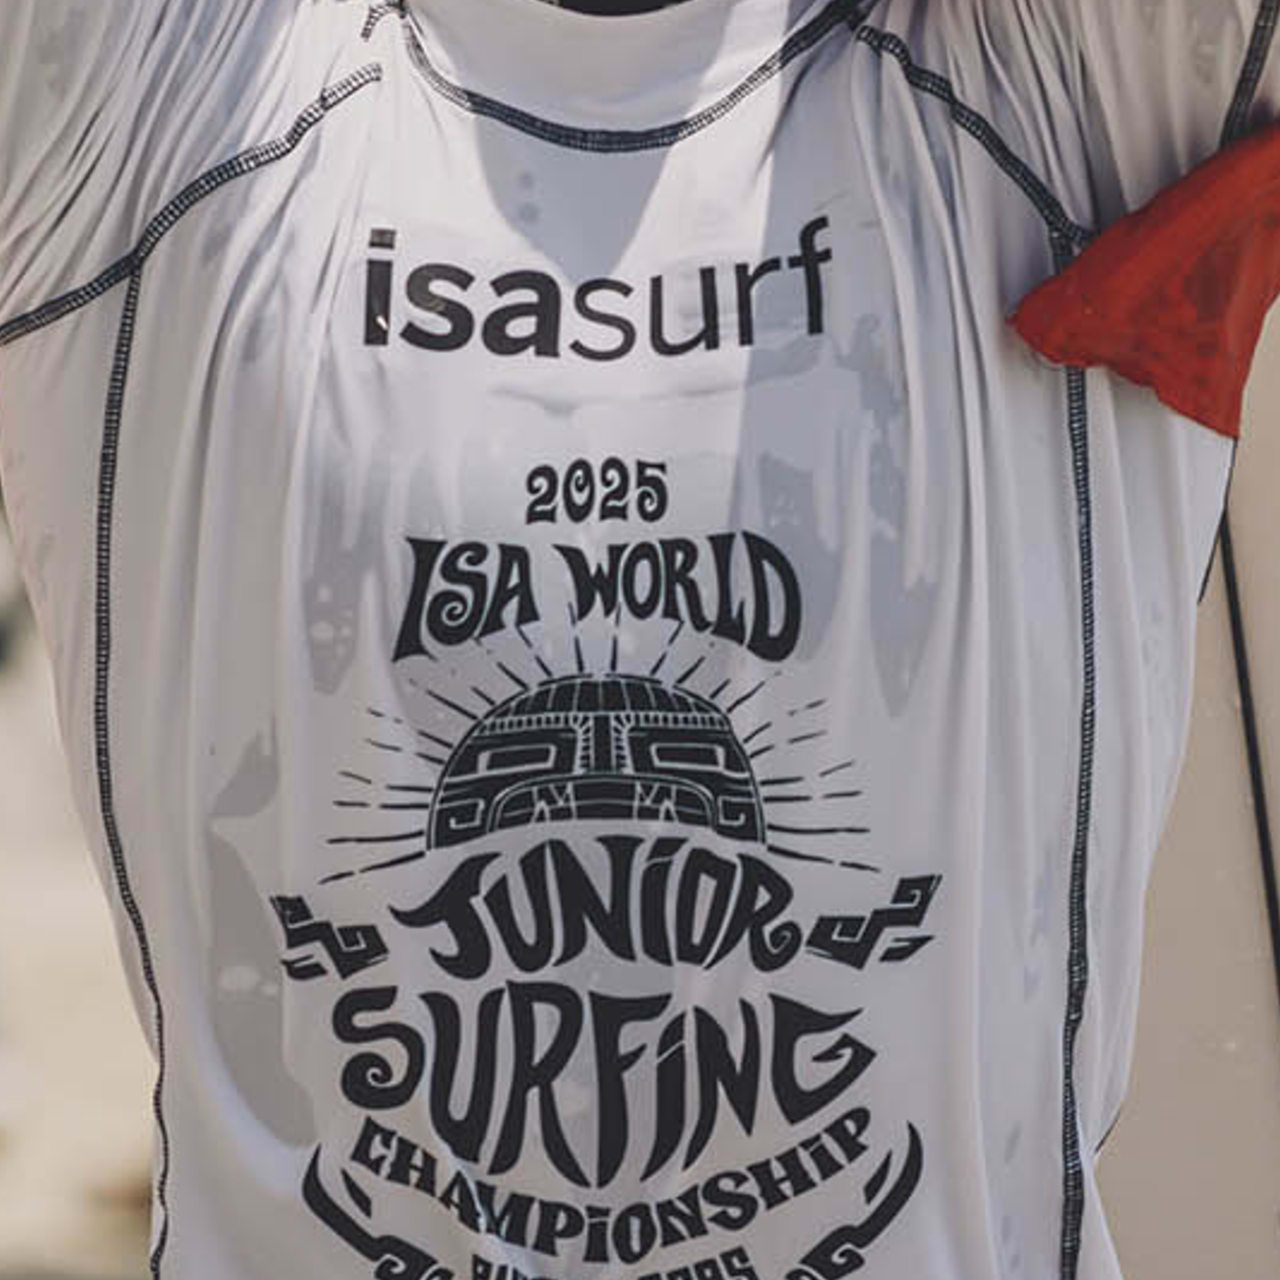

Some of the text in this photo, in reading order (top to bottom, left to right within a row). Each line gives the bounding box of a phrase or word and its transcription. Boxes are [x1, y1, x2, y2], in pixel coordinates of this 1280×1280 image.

[362, 216, 832, 362] isasurf
[524, 458, 668, 524] 2025
[392, 530, 802, 663] ISA WORLD
